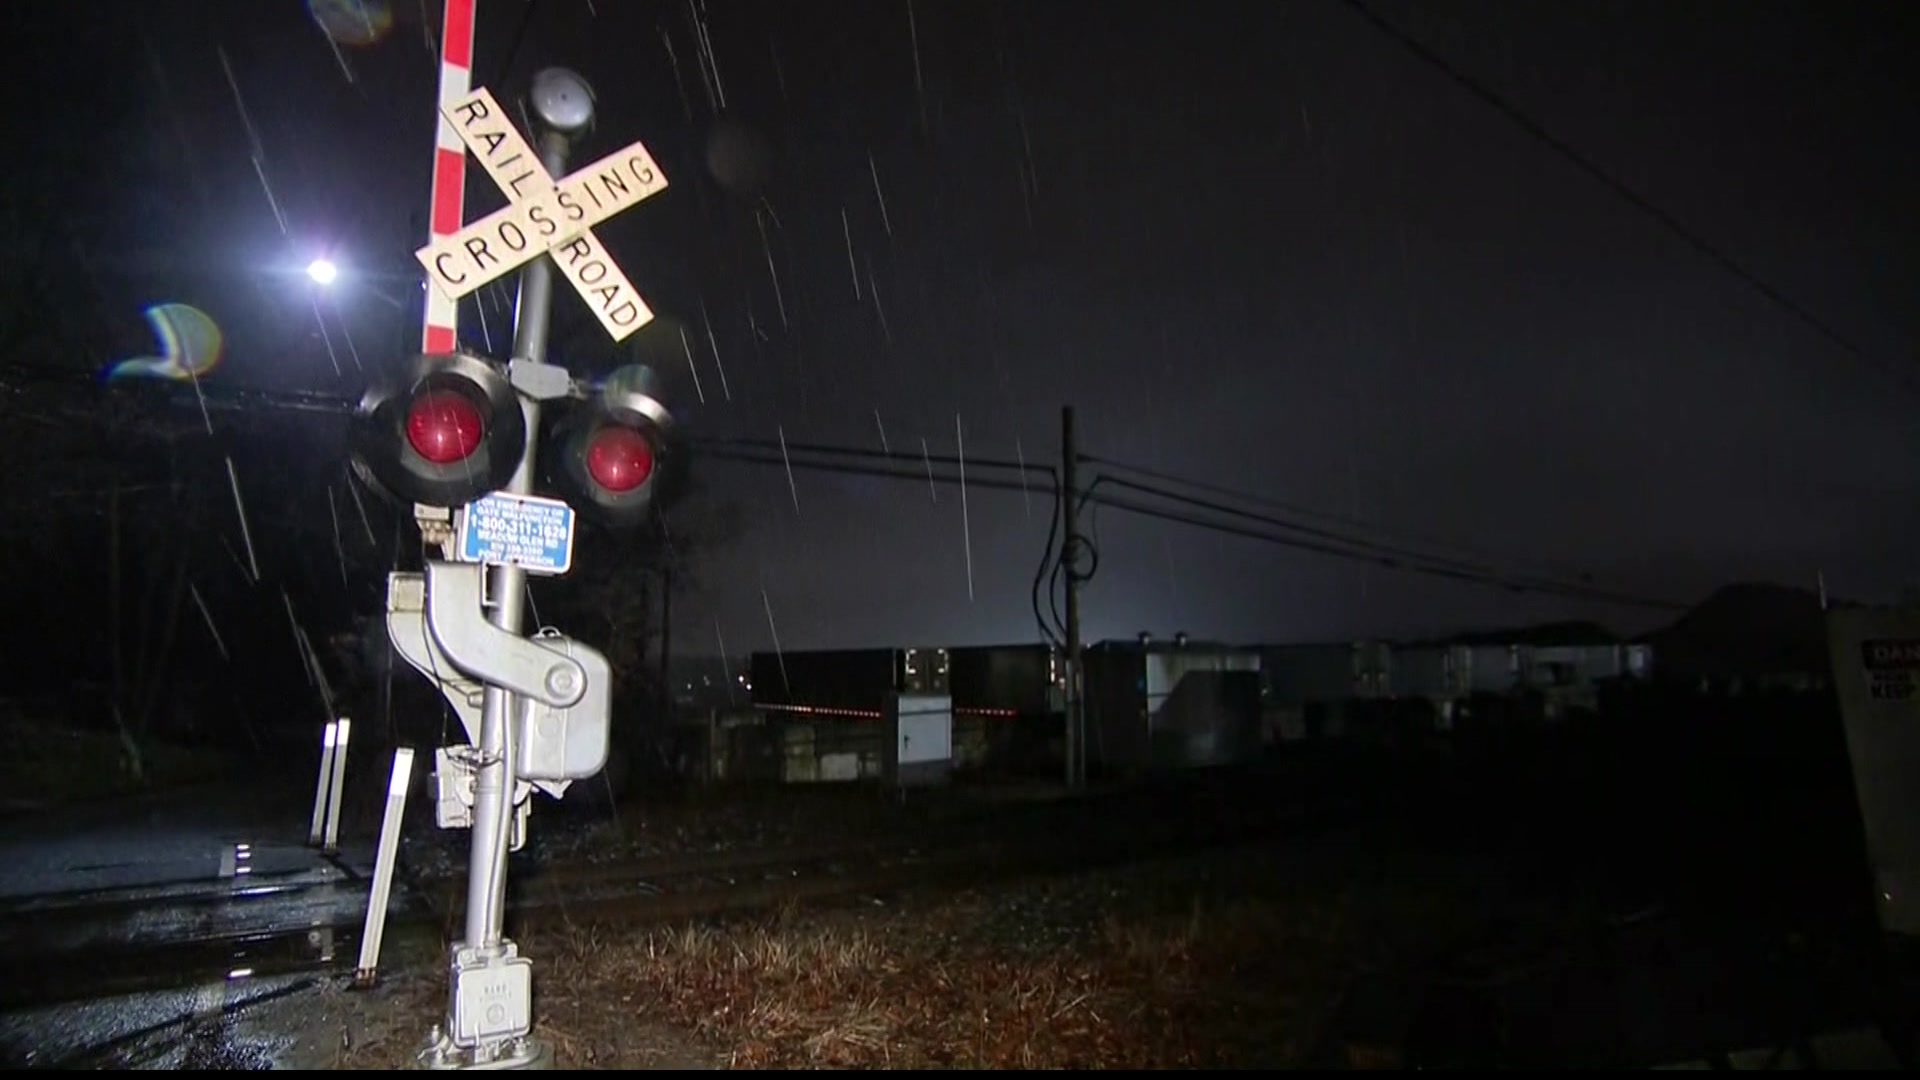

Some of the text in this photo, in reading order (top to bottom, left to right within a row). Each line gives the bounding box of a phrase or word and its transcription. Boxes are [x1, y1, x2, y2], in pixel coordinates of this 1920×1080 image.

[435, 156, 654, 285] CROSSING
[455, 98, 638, 326] RAIL ROAD
